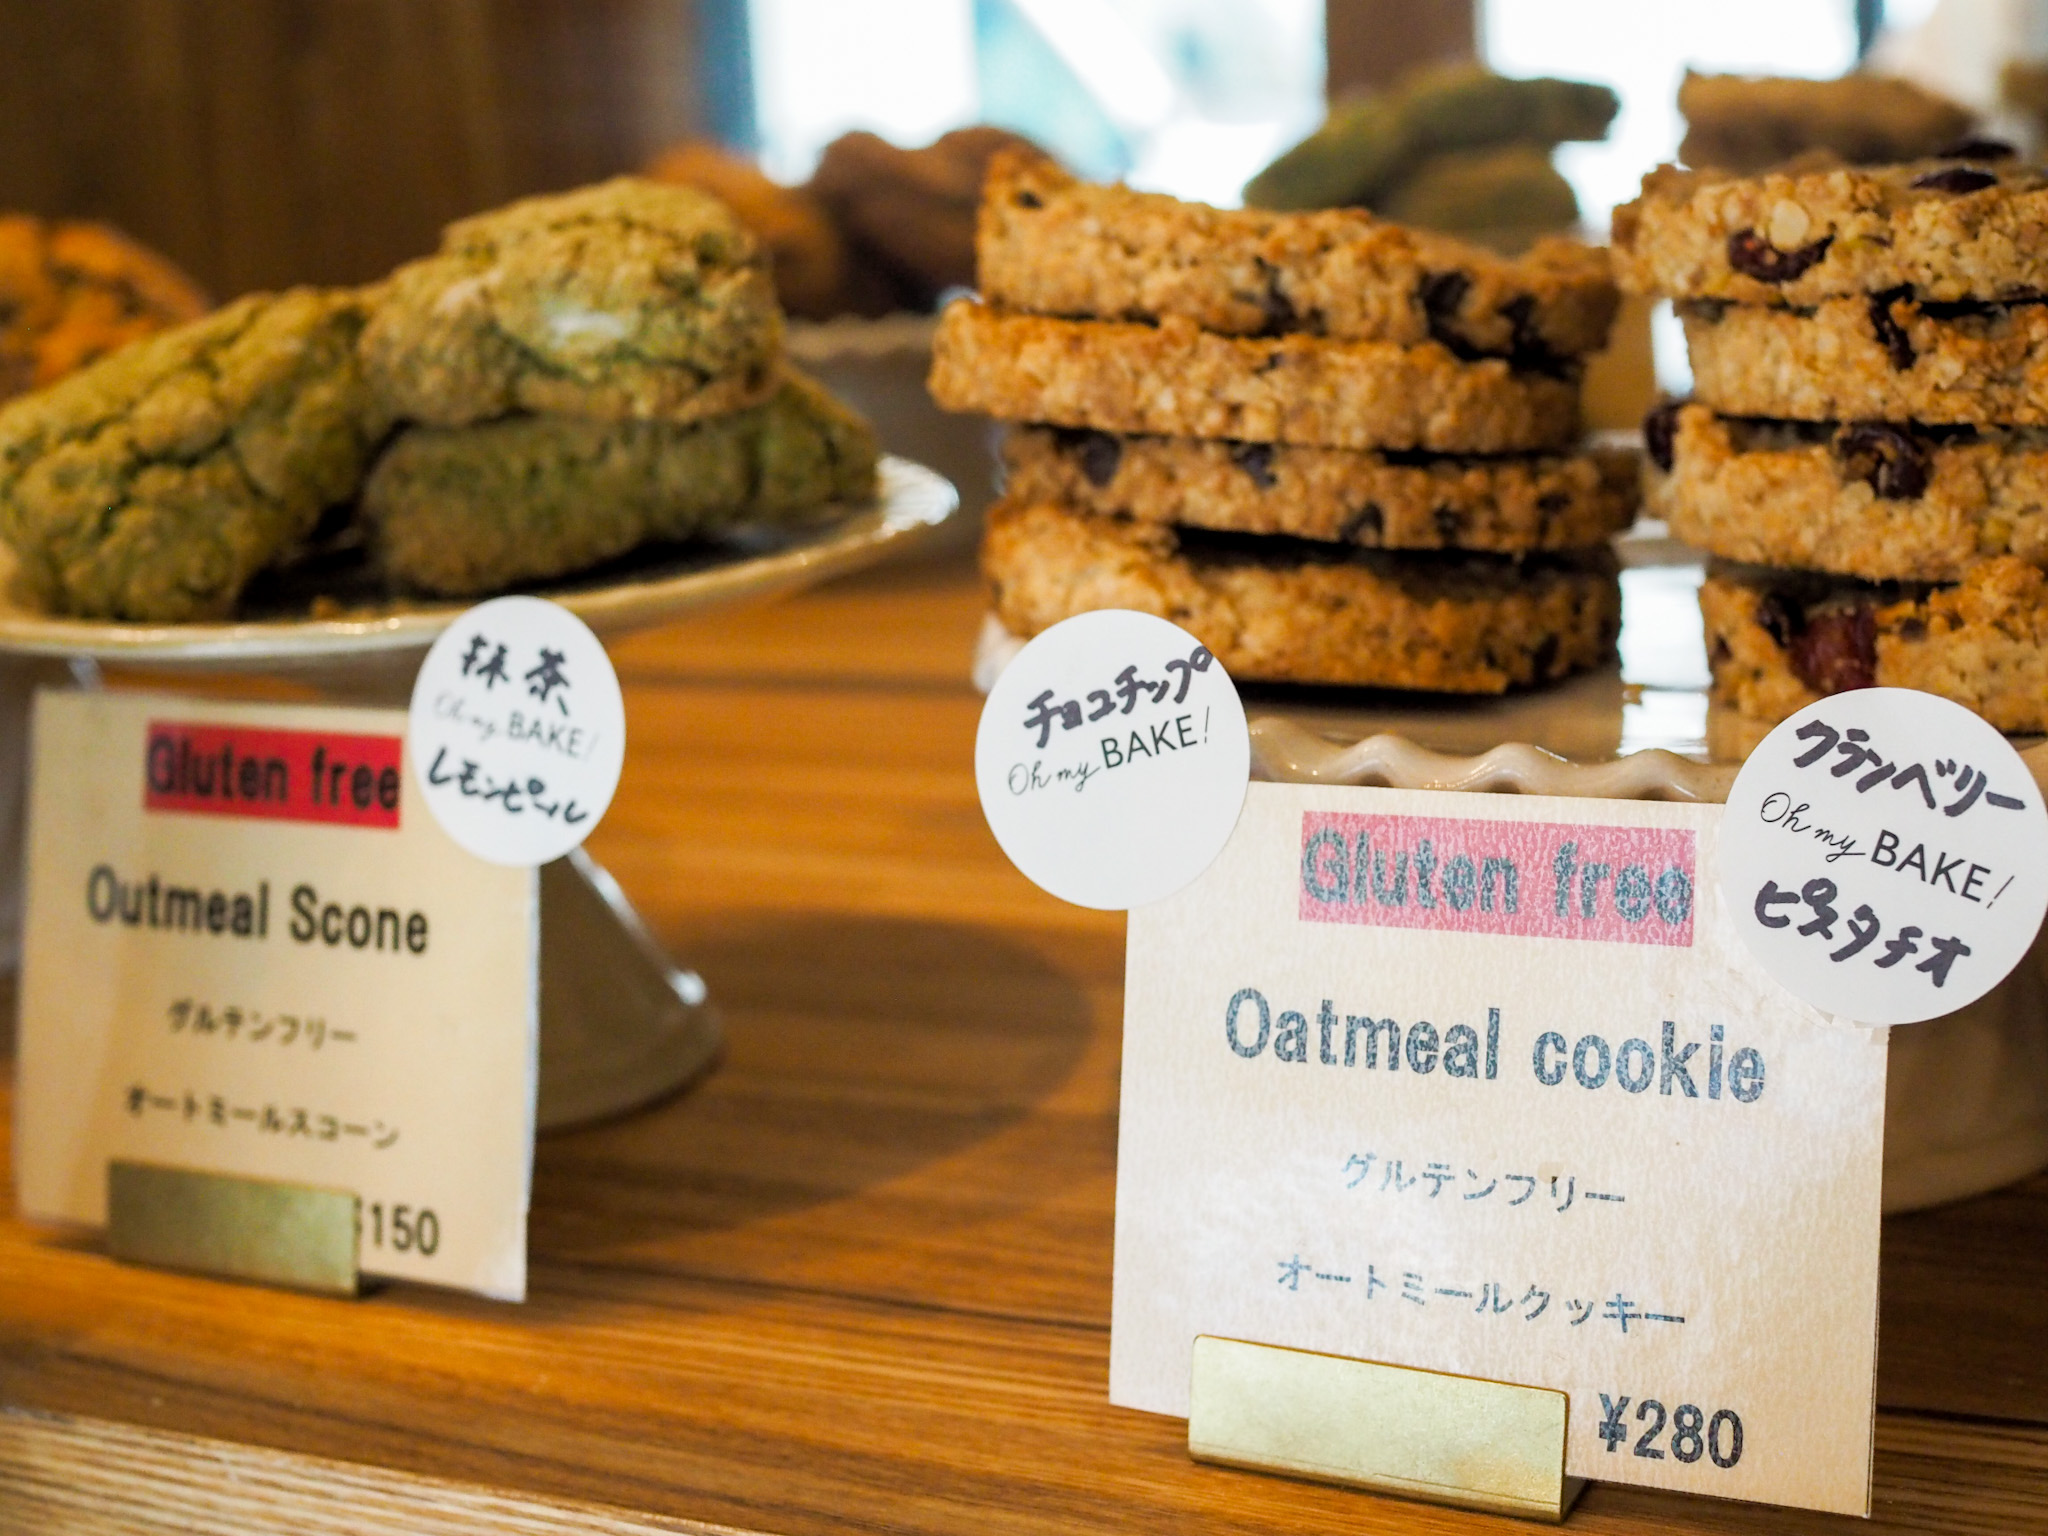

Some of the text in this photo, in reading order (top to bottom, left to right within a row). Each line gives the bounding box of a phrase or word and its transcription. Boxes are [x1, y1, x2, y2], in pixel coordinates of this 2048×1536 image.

[461, 634, 570, 716] 抹茶
[1023, 645, 1214, 749] チョコチップ
[147, 734, 402, 812] Gluten free
[508, 709, 600, 763] BAKE!
[1008, 705, 1210, 796] Oh my BAKE!
[1793, 719, 2026, 818] クランベリー
[428, 746, 588, 824] レモンピール
[1302, 827, 1692, 926] Gluten free
[1760, 791, 2015, 909] Oh my BAKE!
[87, 863, 428, 954] Outmeal Scone
[1754, 877, 1972, 989] ピスタチオ
[167, 998, 359, 1049] グルテンフリー
[1225, 987, 1766, 1104] Oatmeal cookie
[124, 1083, 401, 1149] オートミールスコーン
[1341, 1151, 1625, 1213] グルテンフリー
[355, 1199, 441, 1256] 150
[1276, 1254, 1686, 1333] オートミールクッキー
[1598, 1393, 1744, 1469] ¥280
